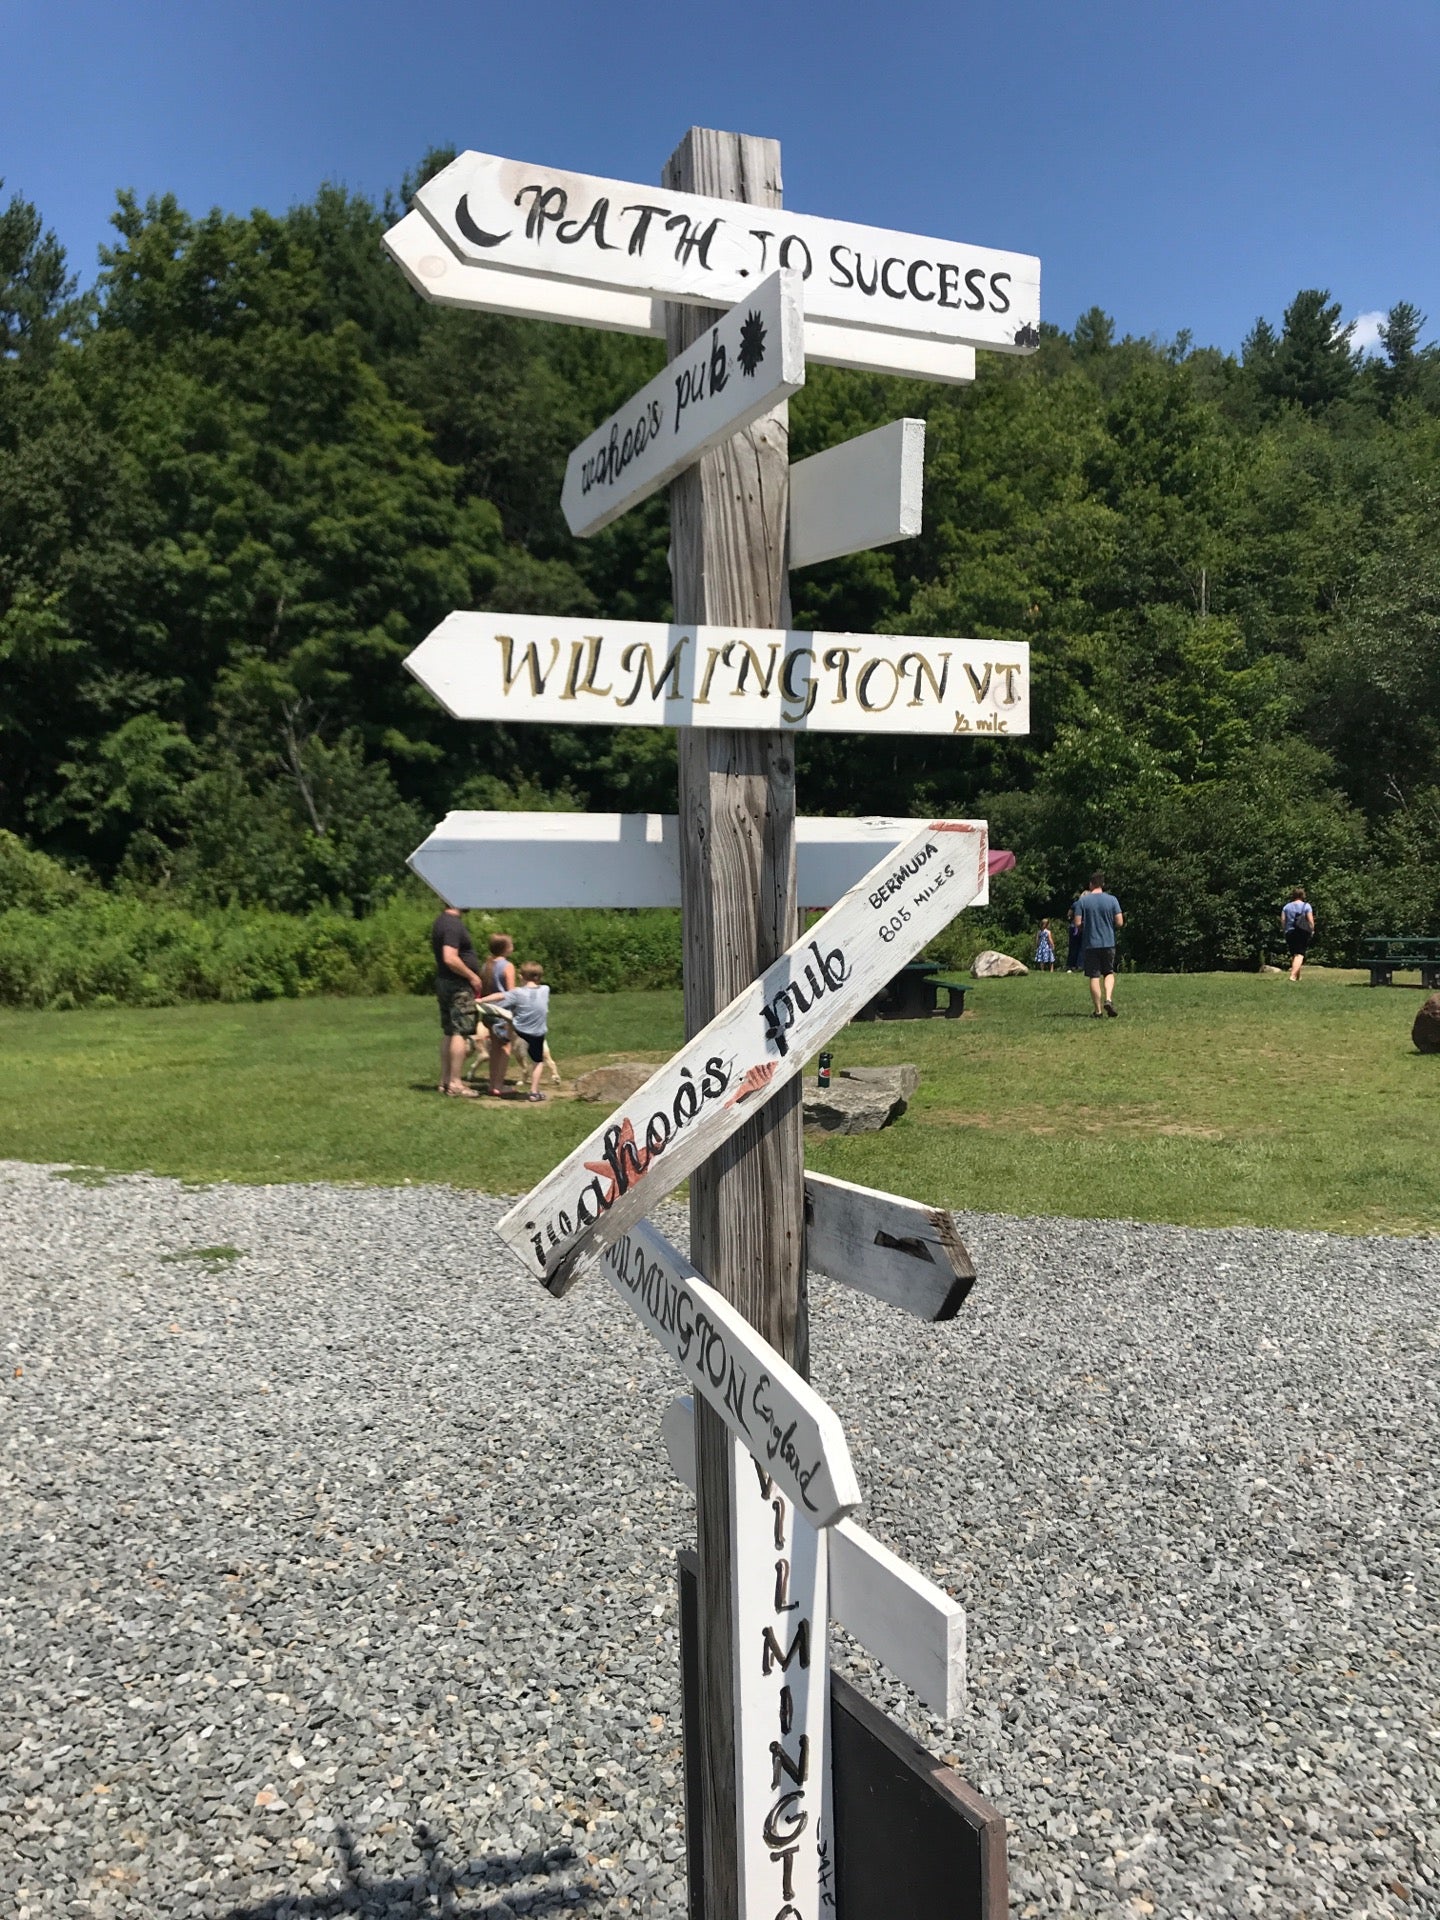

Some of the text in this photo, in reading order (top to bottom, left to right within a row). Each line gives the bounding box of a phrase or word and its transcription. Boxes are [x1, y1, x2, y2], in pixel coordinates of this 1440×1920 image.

[514, 185, 1012, 314] PATH TO SUCCESS
[674, 327, 731, 435] pub
[494, 635, 953, 724] WILMINGTON
[976, 711, 1009, 734] mile
[868, 842, 938, 910] BERMUDA
[878, 863, 955, 943] 805 MILES
[758, 940, 853, 1058] pub
